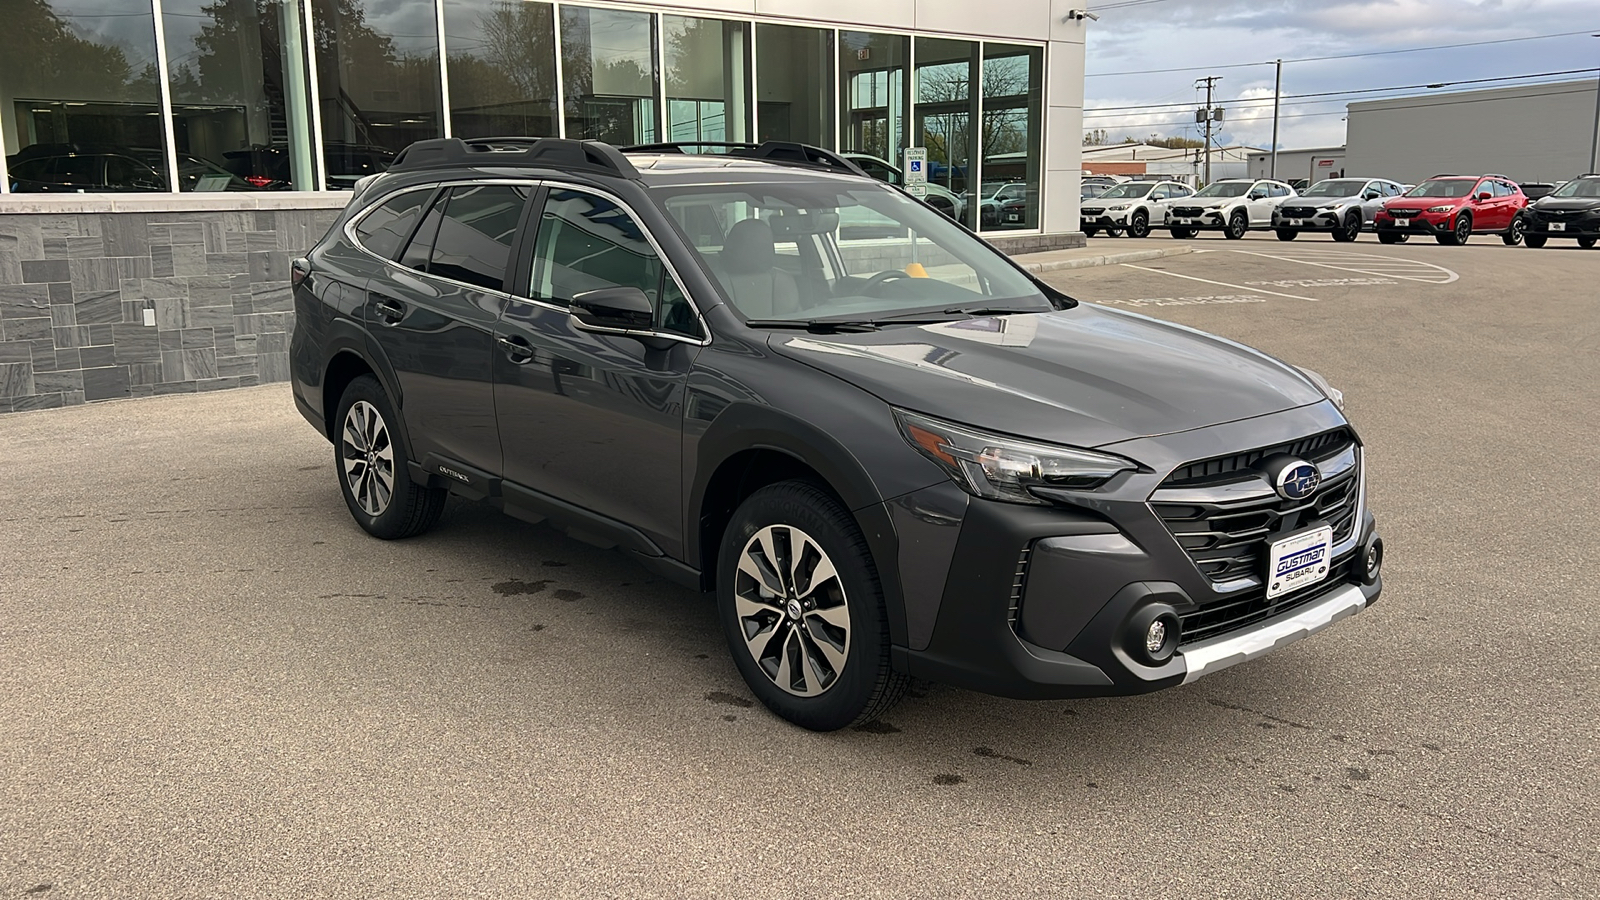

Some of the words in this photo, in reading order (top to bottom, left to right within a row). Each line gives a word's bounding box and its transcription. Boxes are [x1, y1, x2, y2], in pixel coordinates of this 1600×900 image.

[439, 466, 470, 482] OUTBACK
[762, 499, 825, 537] YOKOHAMA
[1285, 567, 1315, 581] SUBARU
